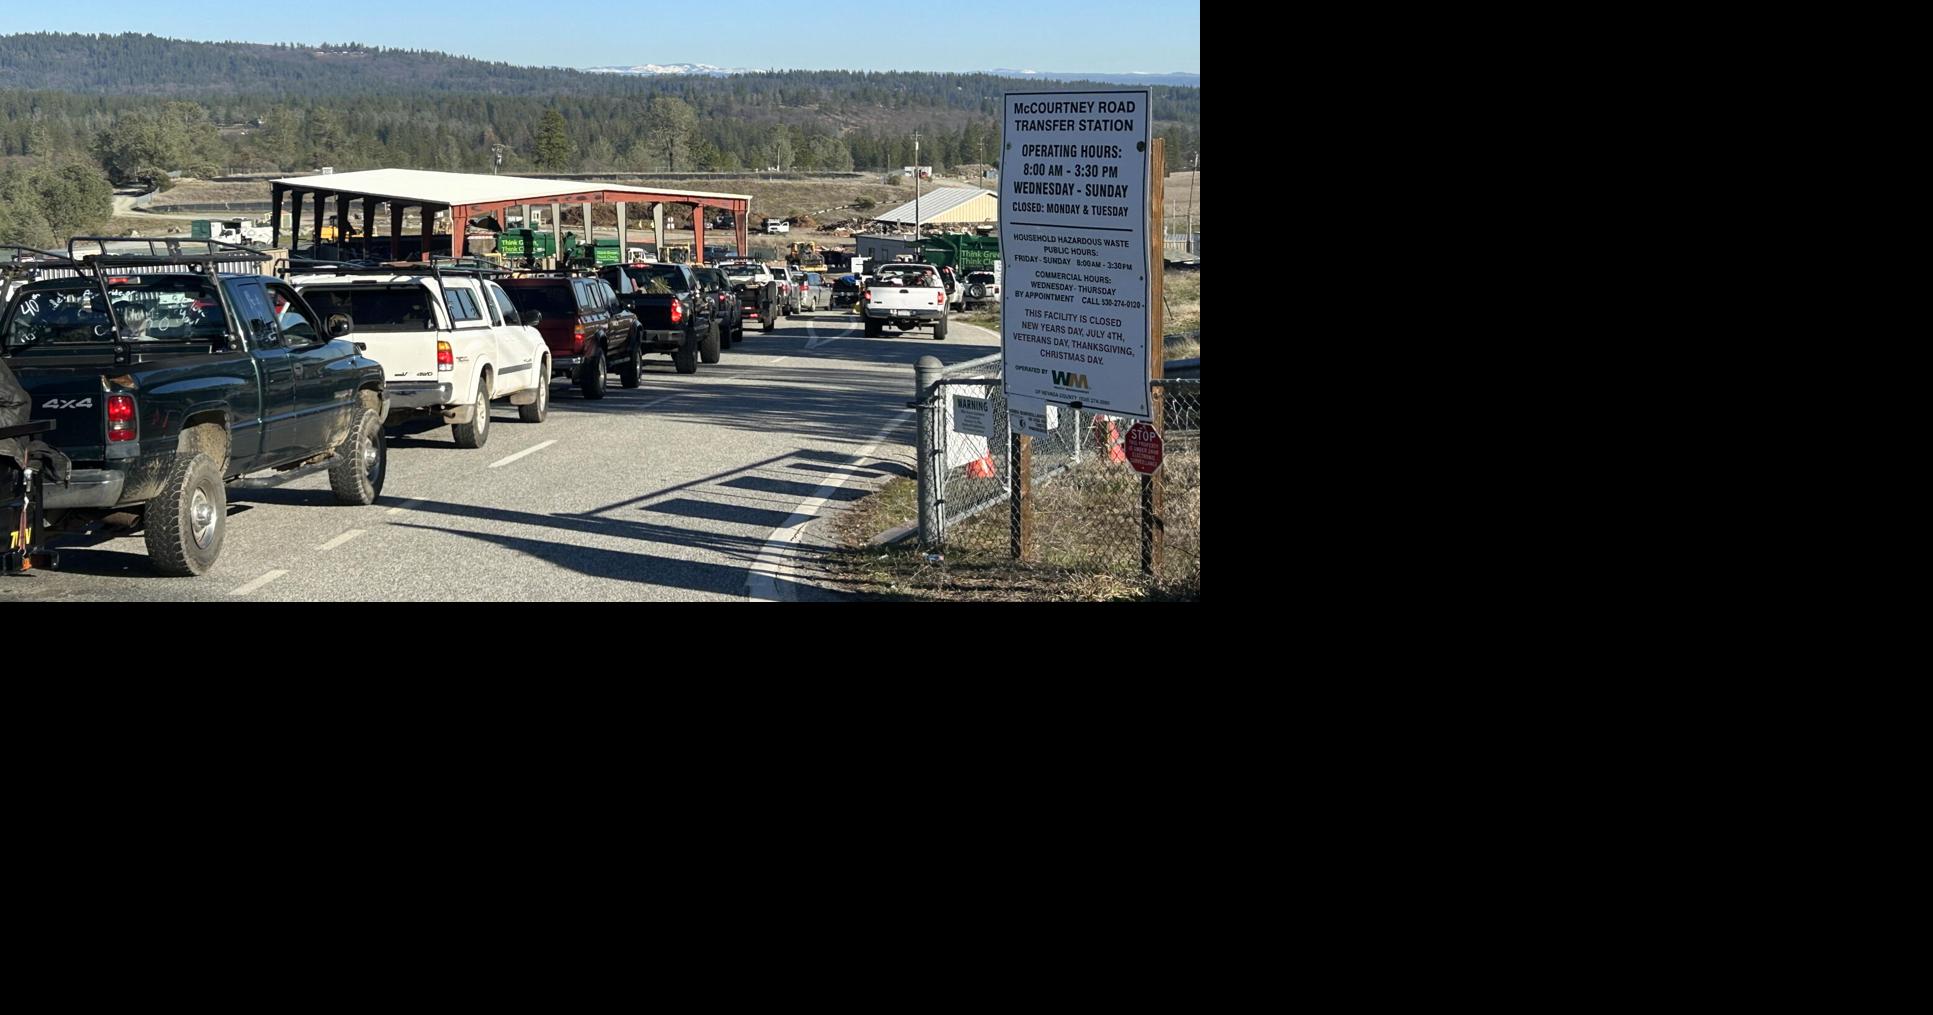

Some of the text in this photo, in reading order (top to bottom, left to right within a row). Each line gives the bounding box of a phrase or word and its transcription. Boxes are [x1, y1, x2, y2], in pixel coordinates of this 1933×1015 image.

[1014, 101, 1136, 114] McCOURTNEY ROAD
[1015, 120, 1133, 132] TRANSFER STATION
[1022, 144, 1122, 159] OPERATING HOURS:
[1023, 163, 1045, 176] 8:00
[1048, 165, 1062, 176] AM
[1075, 164, 1098, 178] 3:30
[1102, 166, 1118, 178] PM
[1014, 181, 1074, 196] WEDNESDAY
[1085, 184, 1128, 198] SUNDAY
[1013, 202, 1128, 217] CLOSED: MONDAY & TUESDAY
[1014, 233, 1129, 248] HOUSEHOLD HAZARDOUS WASTE
[962, 250, 981, 258] Think
[1044, 246, 1098, 256] PUBLIC HOURS:
[962, 257, 981, 265] Think
[1014, 254, 1038, 263] FRIDAY
[1043, 256, 1071, 266] SUNDAY
[1035, 270, 1112, 284] COMMERCIAL HOURS:
[1031, 281, 1073, 291] WEDNESDAY
[1078, 285, 1117, 296] THURSDAY
[1015, 290, 1024, 298] BY
[1025, 291, 1074, 303] APPOINTMENT
[1082, 297, 1100, 306] CALL
[1025, 308, 1122, 327] THIS FACILITY IS CLOSED
[1022, 321, 1125, 342] NEW YEARS DAY, JULY 4TH,
[1013, 332, 1135, 357] VETERANS DAY, THANKSGIVING,
[1040, 349, 1104, 365] CHRISTMAS DAY.
[1015, 365, 1040, 374] OPERATED
[1052, 370, 1089, 390] WM
[1060, 393, 1077, 401] COUNTY
[957, 399, 988, 412] WARNING
[1131, 429, 1156, 441] STOP
